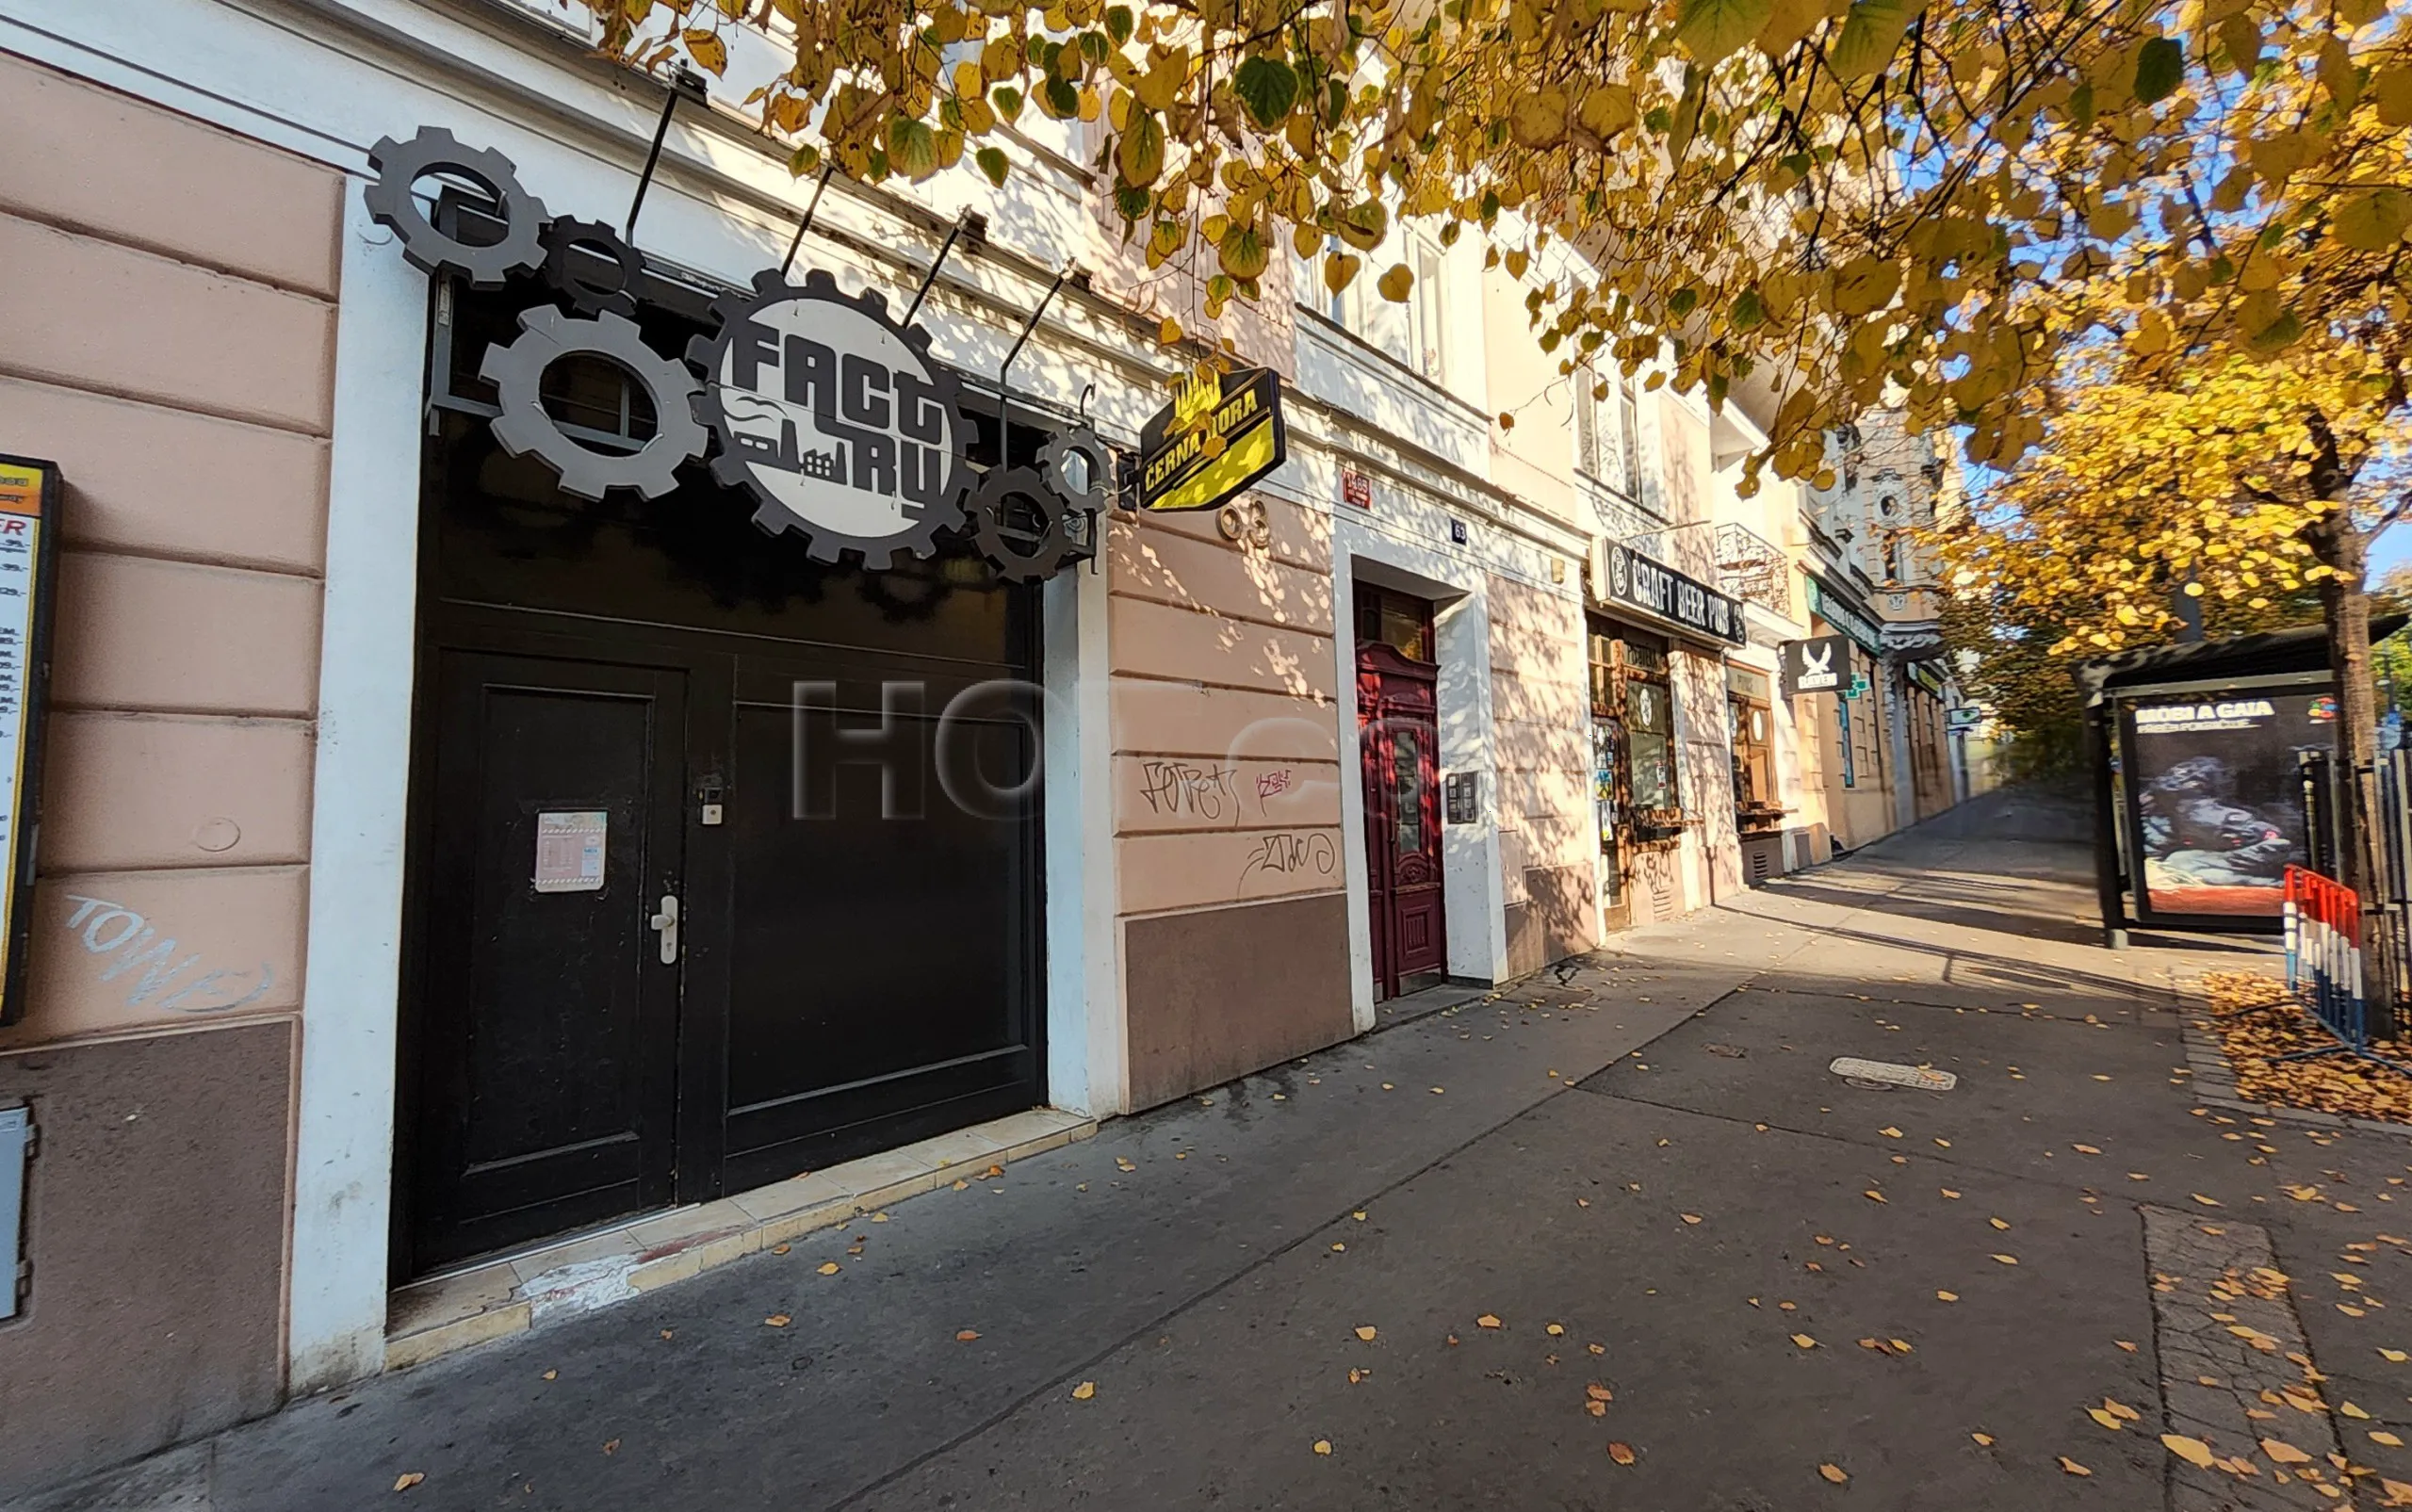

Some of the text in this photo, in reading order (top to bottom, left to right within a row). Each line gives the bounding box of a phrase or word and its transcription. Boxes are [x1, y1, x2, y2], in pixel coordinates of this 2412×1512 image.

[1455, 524, 1466, 541] 63
[1632, 559, 1731, 636] CRAFT BEER PUB
[2196, 705, 2216, 720] A
[2216, 700, 2275, 719] GAIA
